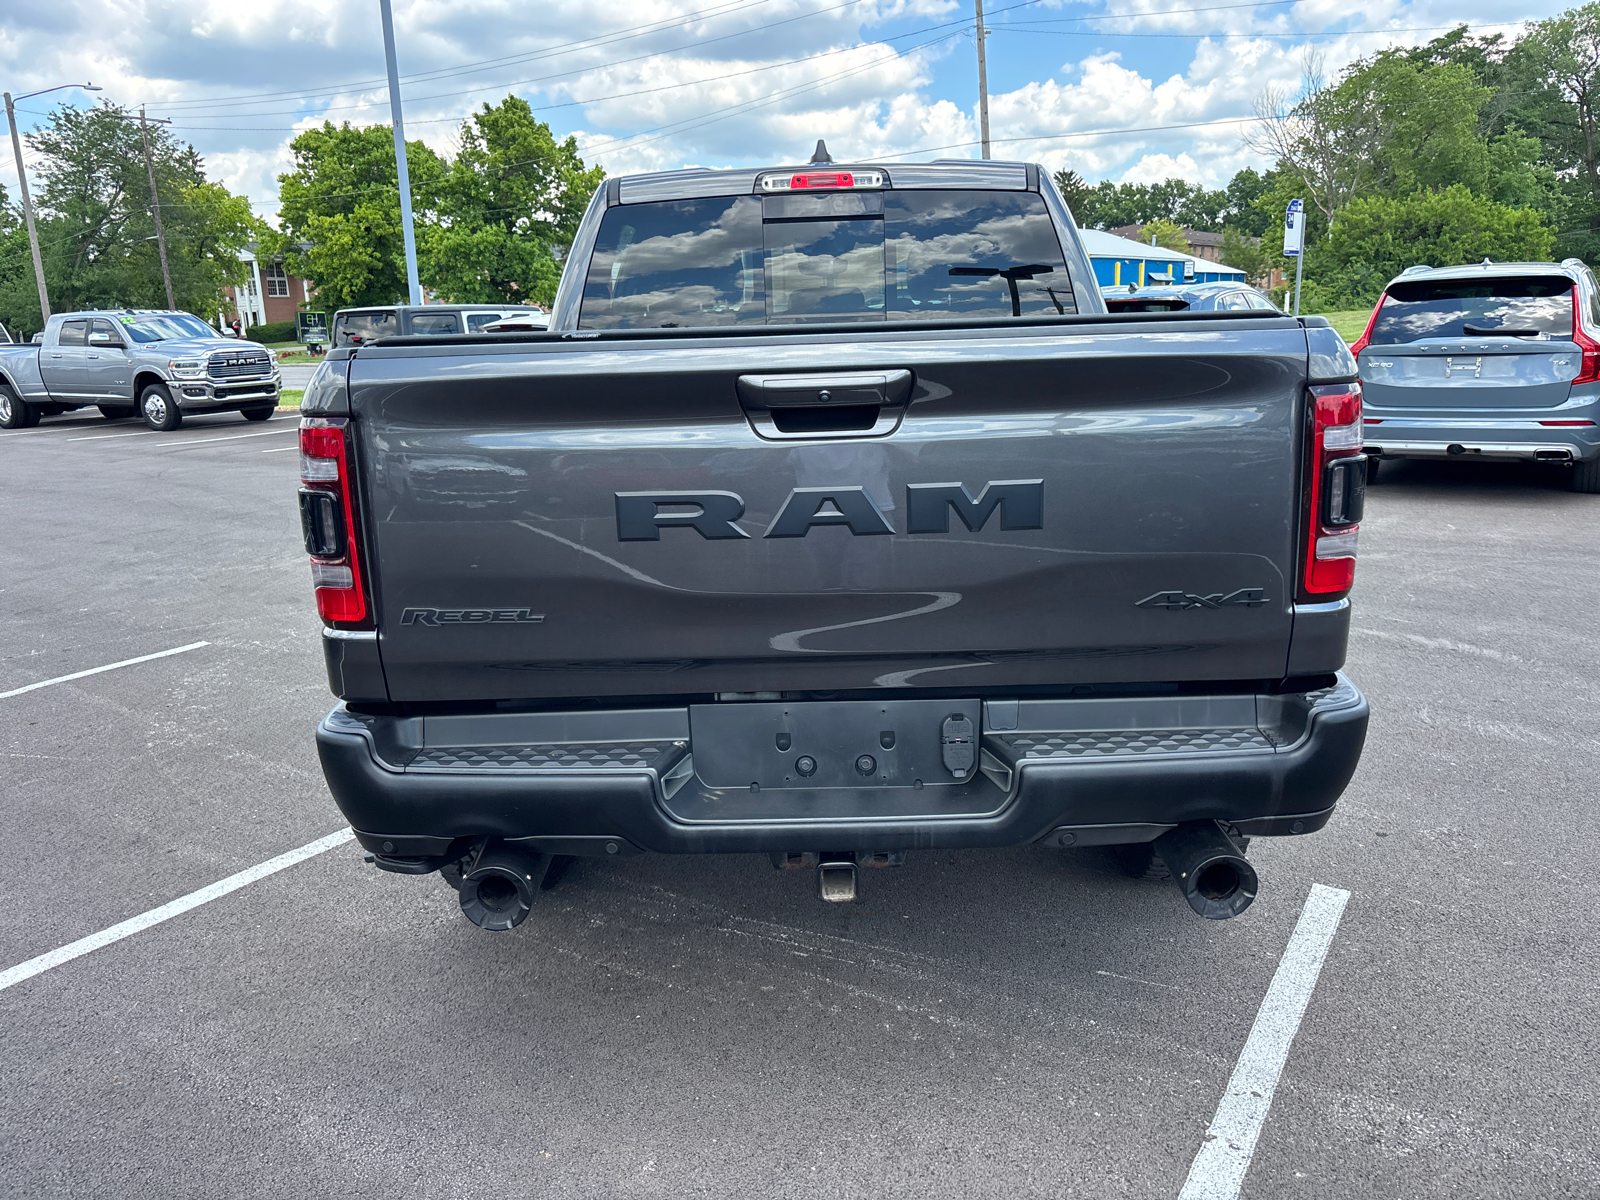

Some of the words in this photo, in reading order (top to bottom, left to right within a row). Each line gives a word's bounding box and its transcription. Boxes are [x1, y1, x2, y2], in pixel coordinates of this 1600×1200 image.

[120, 316, 137, 324] 22
[228, 358, 255, 366] RAM
[614, 478, 1044, 542] RAM
[400, 607, 546, 627] REBEL
